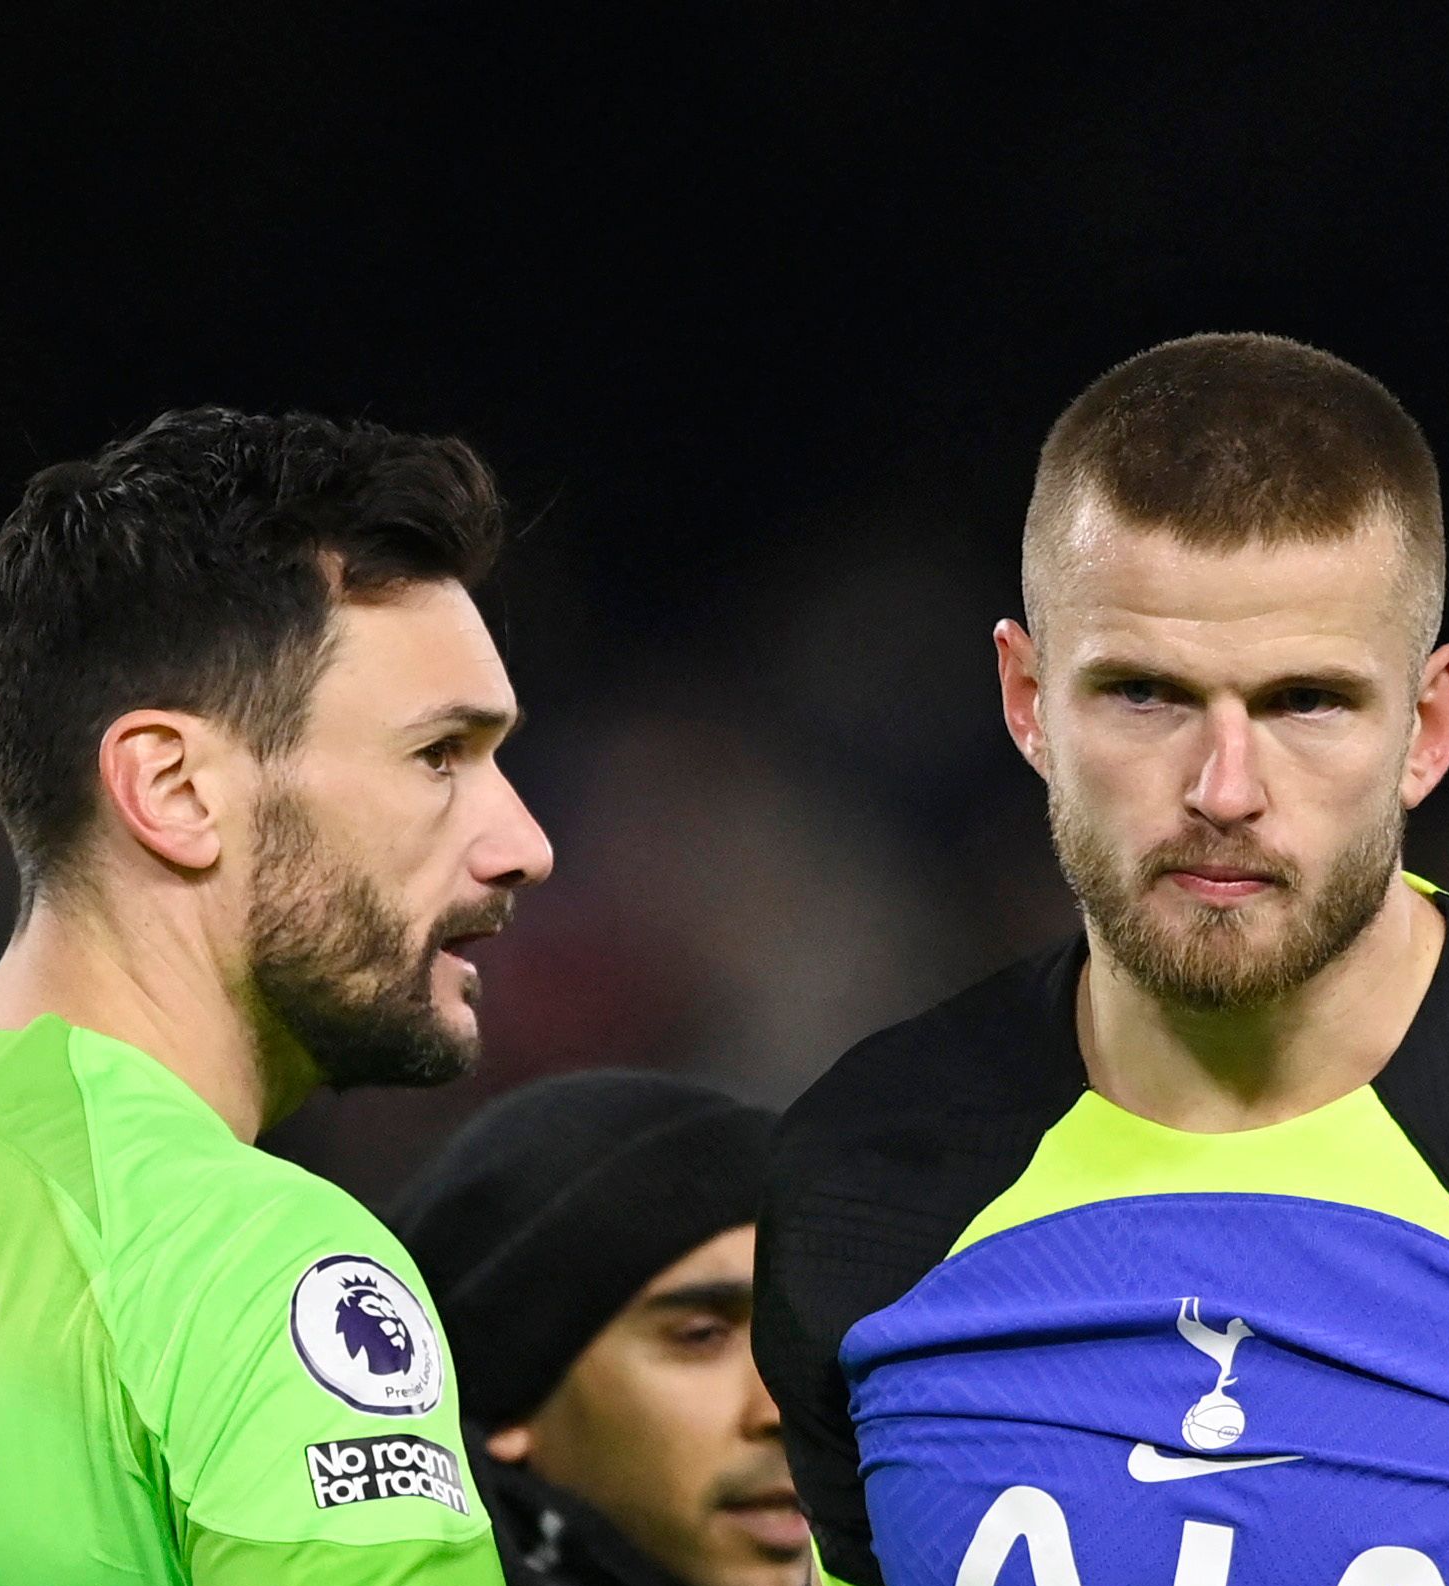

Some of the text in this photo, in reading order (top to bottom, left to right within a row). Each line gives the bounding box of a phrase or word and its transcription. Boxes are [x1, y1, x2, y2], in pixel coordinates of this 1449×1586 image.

[306, 1441, 454, 1482] No room
[313, 1470, 470, 1515] for racism
